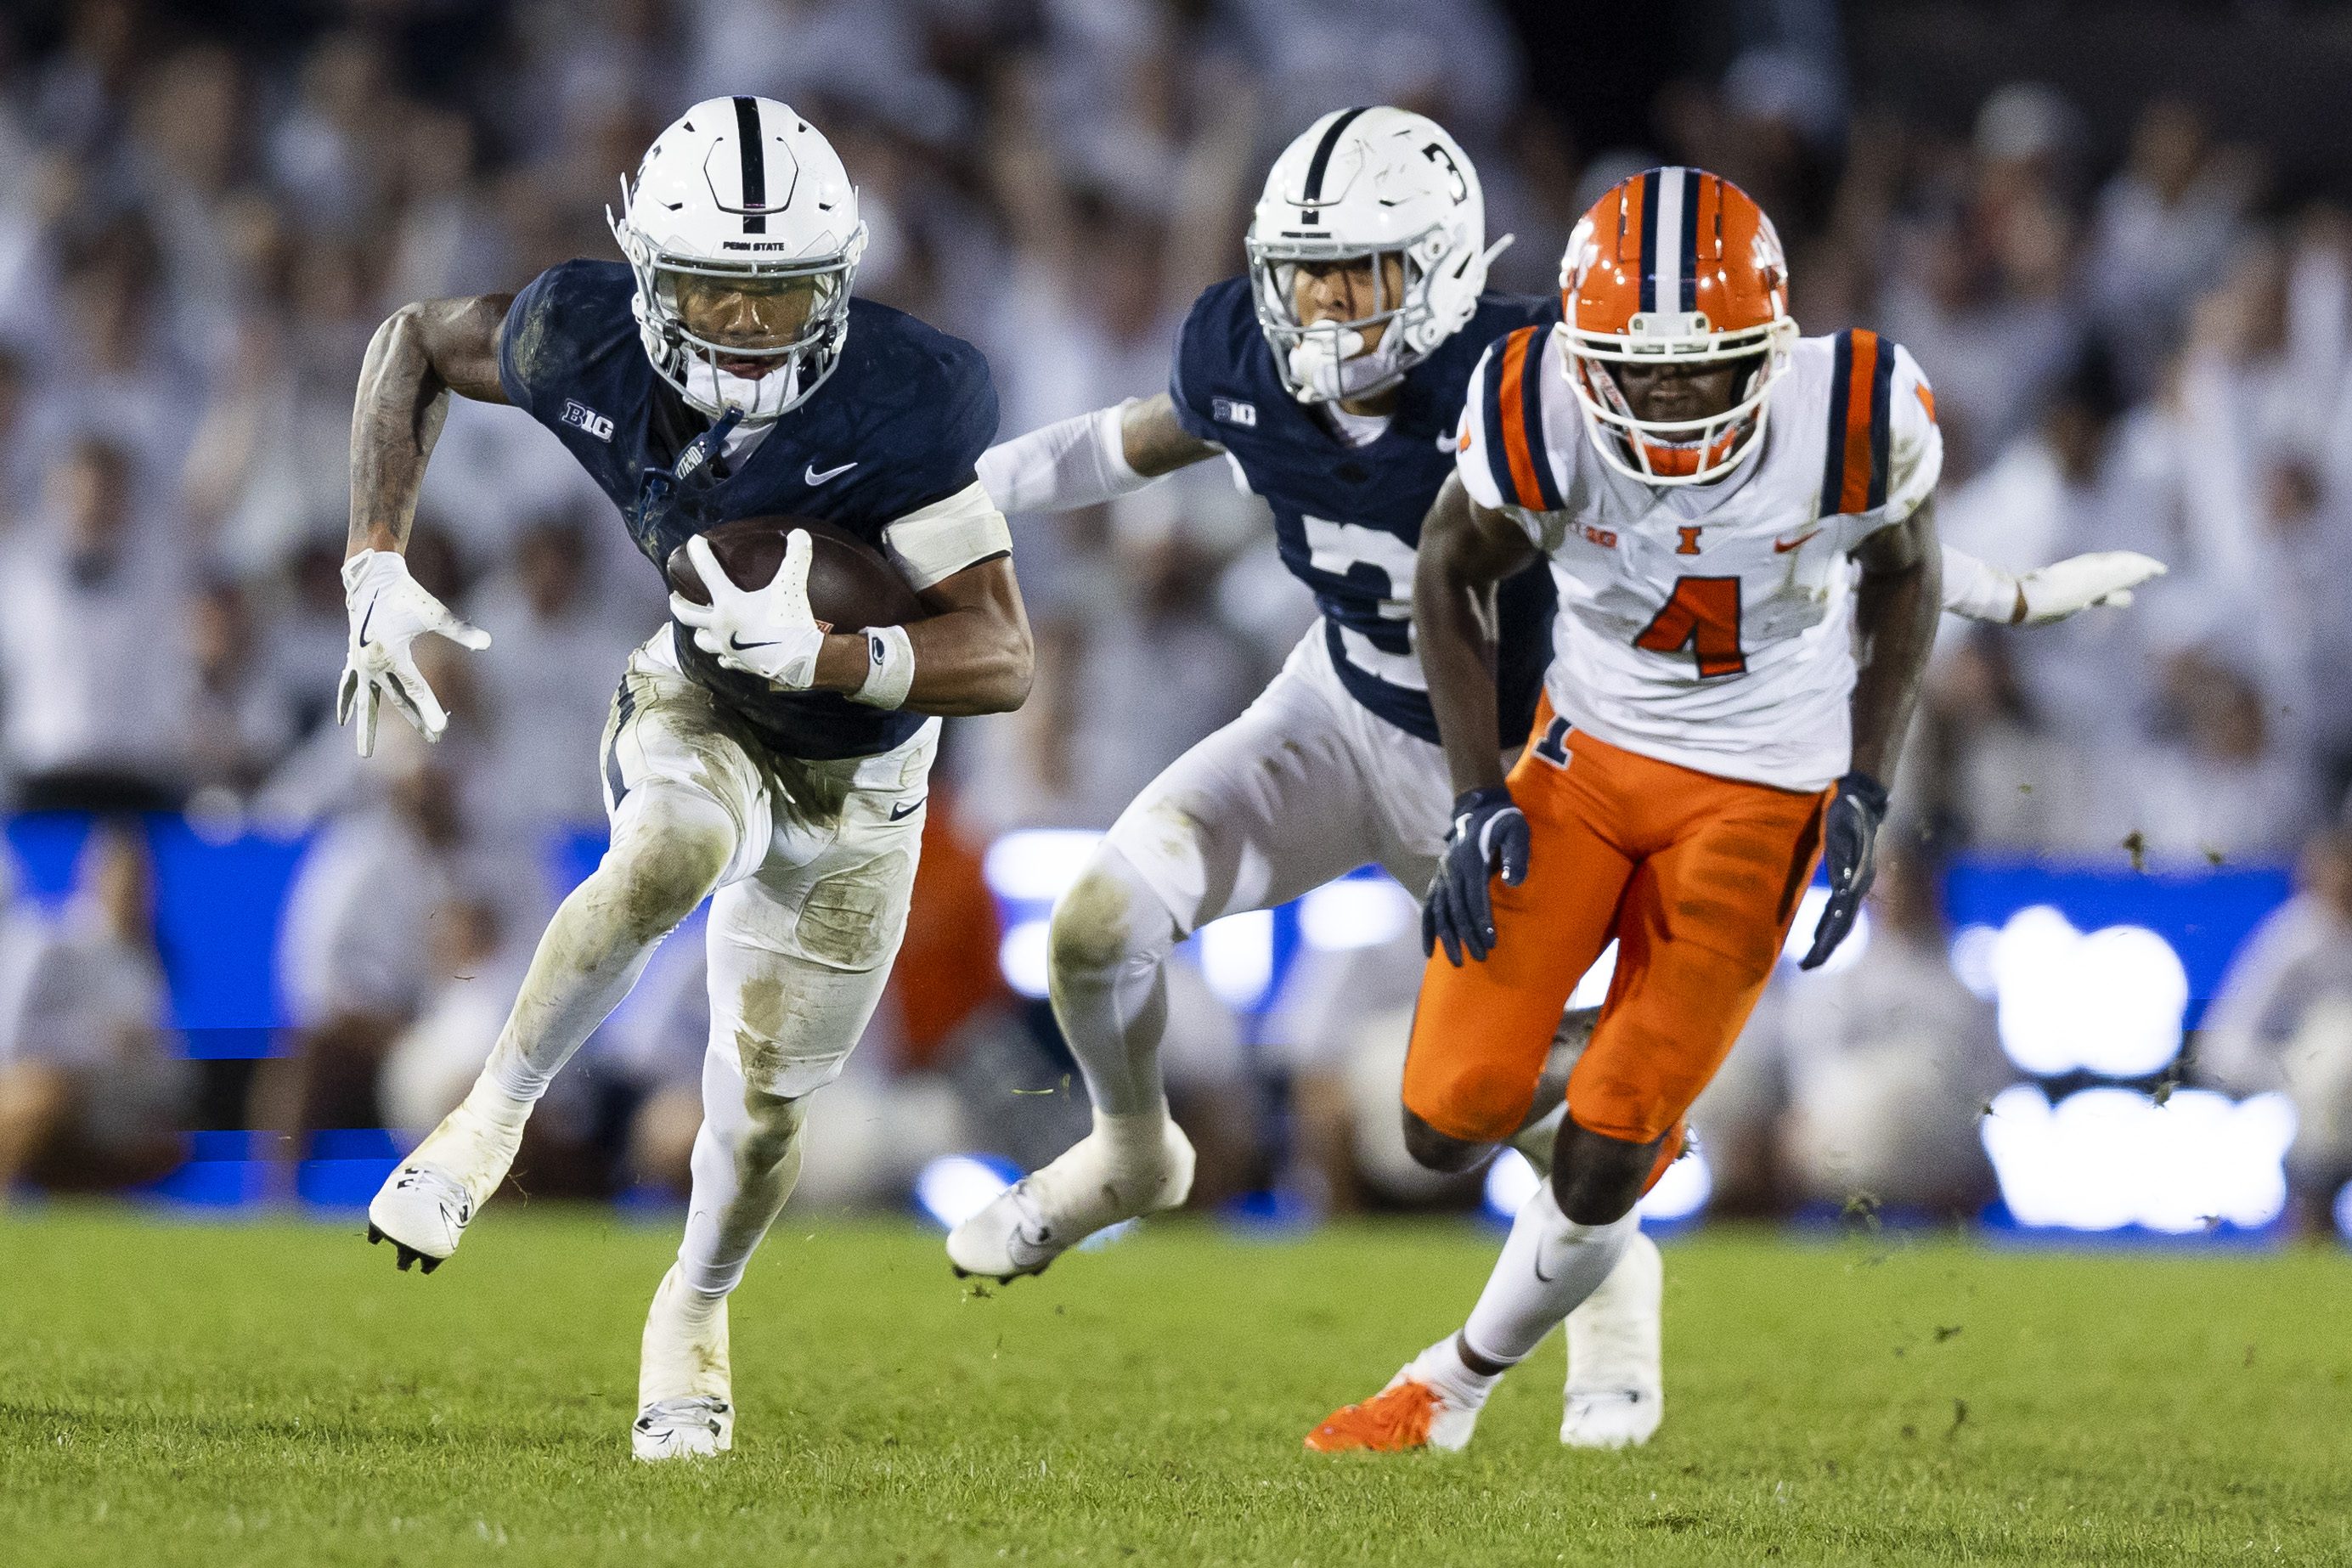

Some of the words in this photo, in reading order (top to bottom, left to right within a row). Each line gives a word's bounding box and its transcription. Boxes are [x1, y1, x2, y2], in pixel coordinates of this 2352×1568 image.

[723, 241, 751, 251] PENN
[753, 242, 785, 251] STATE
[561, 401, 614, 440] BIG
[1676, 526, 1702, 555] I
[1301, 514, 1430, 692] 3
[1632, 575, 1747, 679] 4
